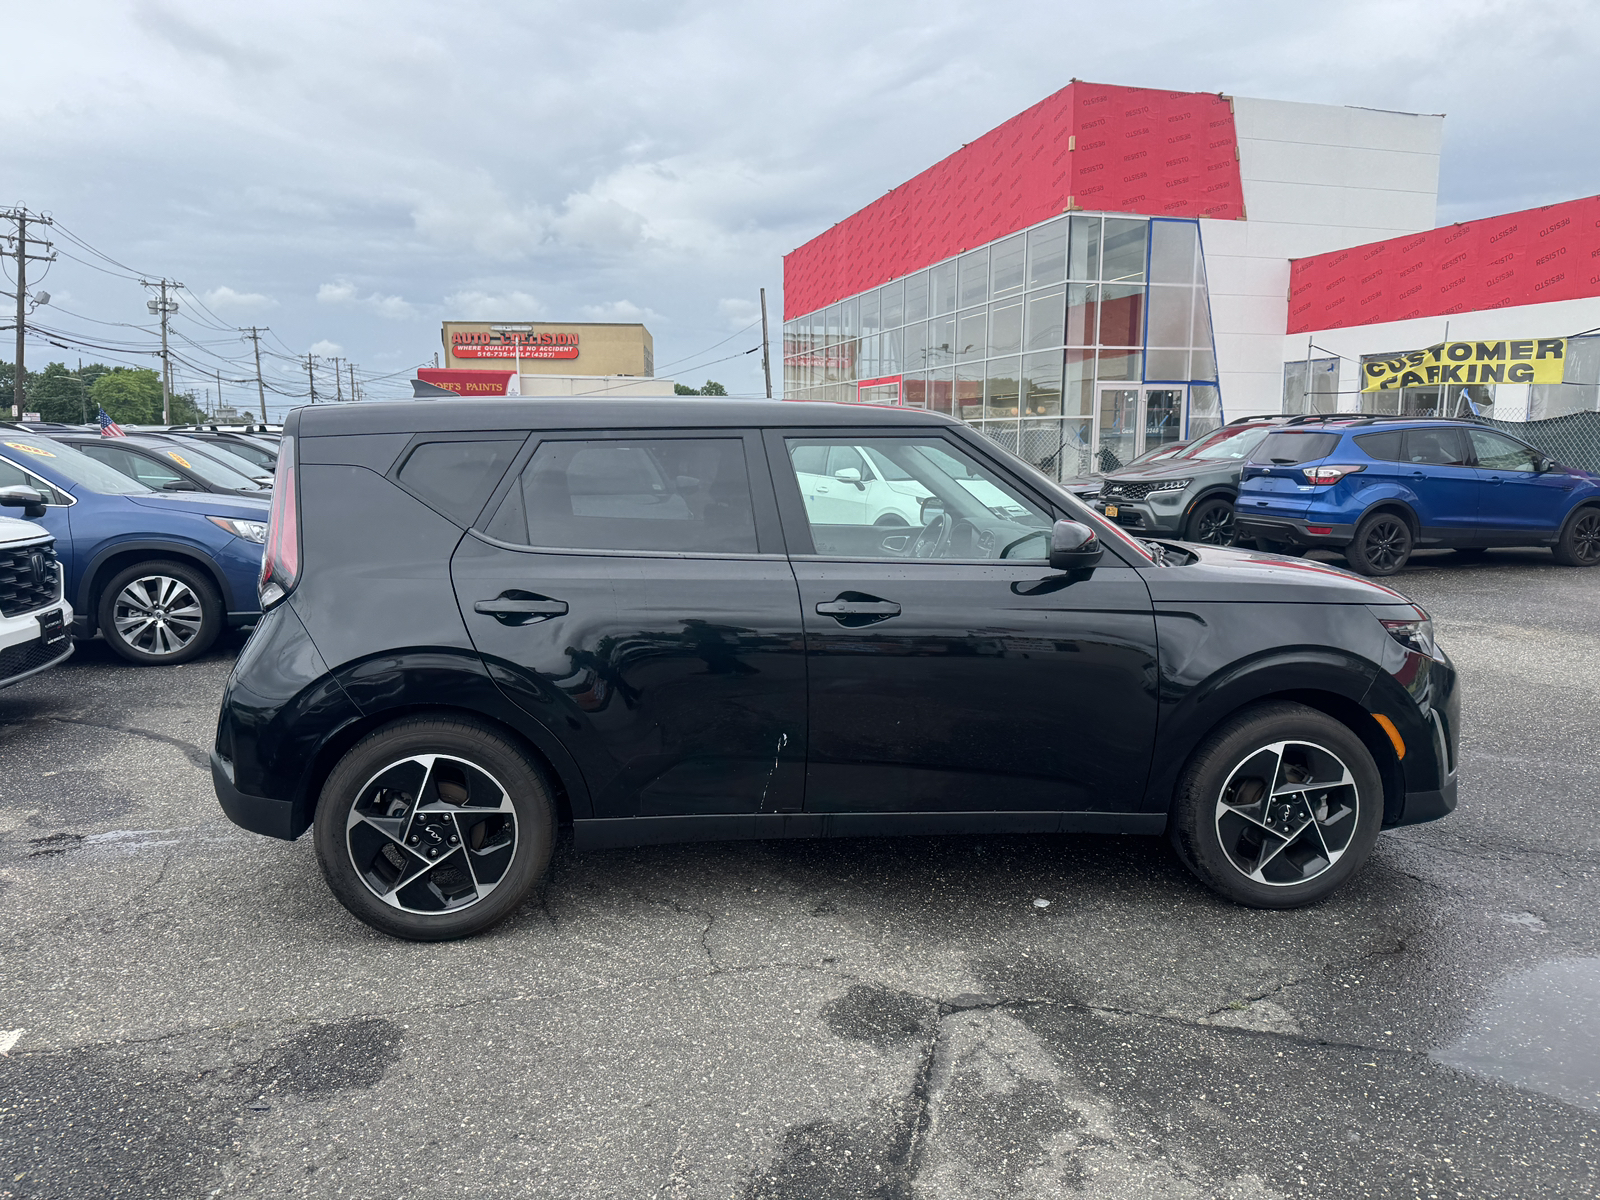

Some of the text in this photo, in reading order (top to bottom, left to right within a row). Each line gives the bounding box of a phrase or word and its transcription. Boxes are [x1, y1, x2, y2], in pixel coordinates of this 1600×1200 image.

[1125, 106, 1149, 117] RESISTO
[1081, 118, 1105, 130] RESISTO
[1124, 150, 1147, 161] RESISTO
[1166, 156, 1189, 167] RESISTO
[1080, 163, 1104, 175] RESISTO
[1207, 161, 1230, 171] RESISTO
[1122, 194, 1146, 206] RESISTO
[1164, 200, 1188, 211] RESISTO
[1489, 224, 1518, 244] RESISTO
[1540, 217, 1570, 238] RESISTO
[1441, 252, 1467, 271] RESISTO
[1535, 246, 1566, 266] RESISTO
[1361, 269, 1383, 285] RESISTO
[1399, 261, 1423, 278] RESISTO
[1325, 276, 1346, 291] RESISTO
[1440, 275, 1466, 294] RESISTO
[1486, 269, 1514, 288] RESISTO
[1534, 272, 1565, 291] RESISTO
[1293, 282, 1312, 297] RESISTO
[452, 332, 579, 345] AUTO COLLISION
[1365, 339, 1565, 377] CUSTOMER
[466, 382, 503, 392] PAINTS
